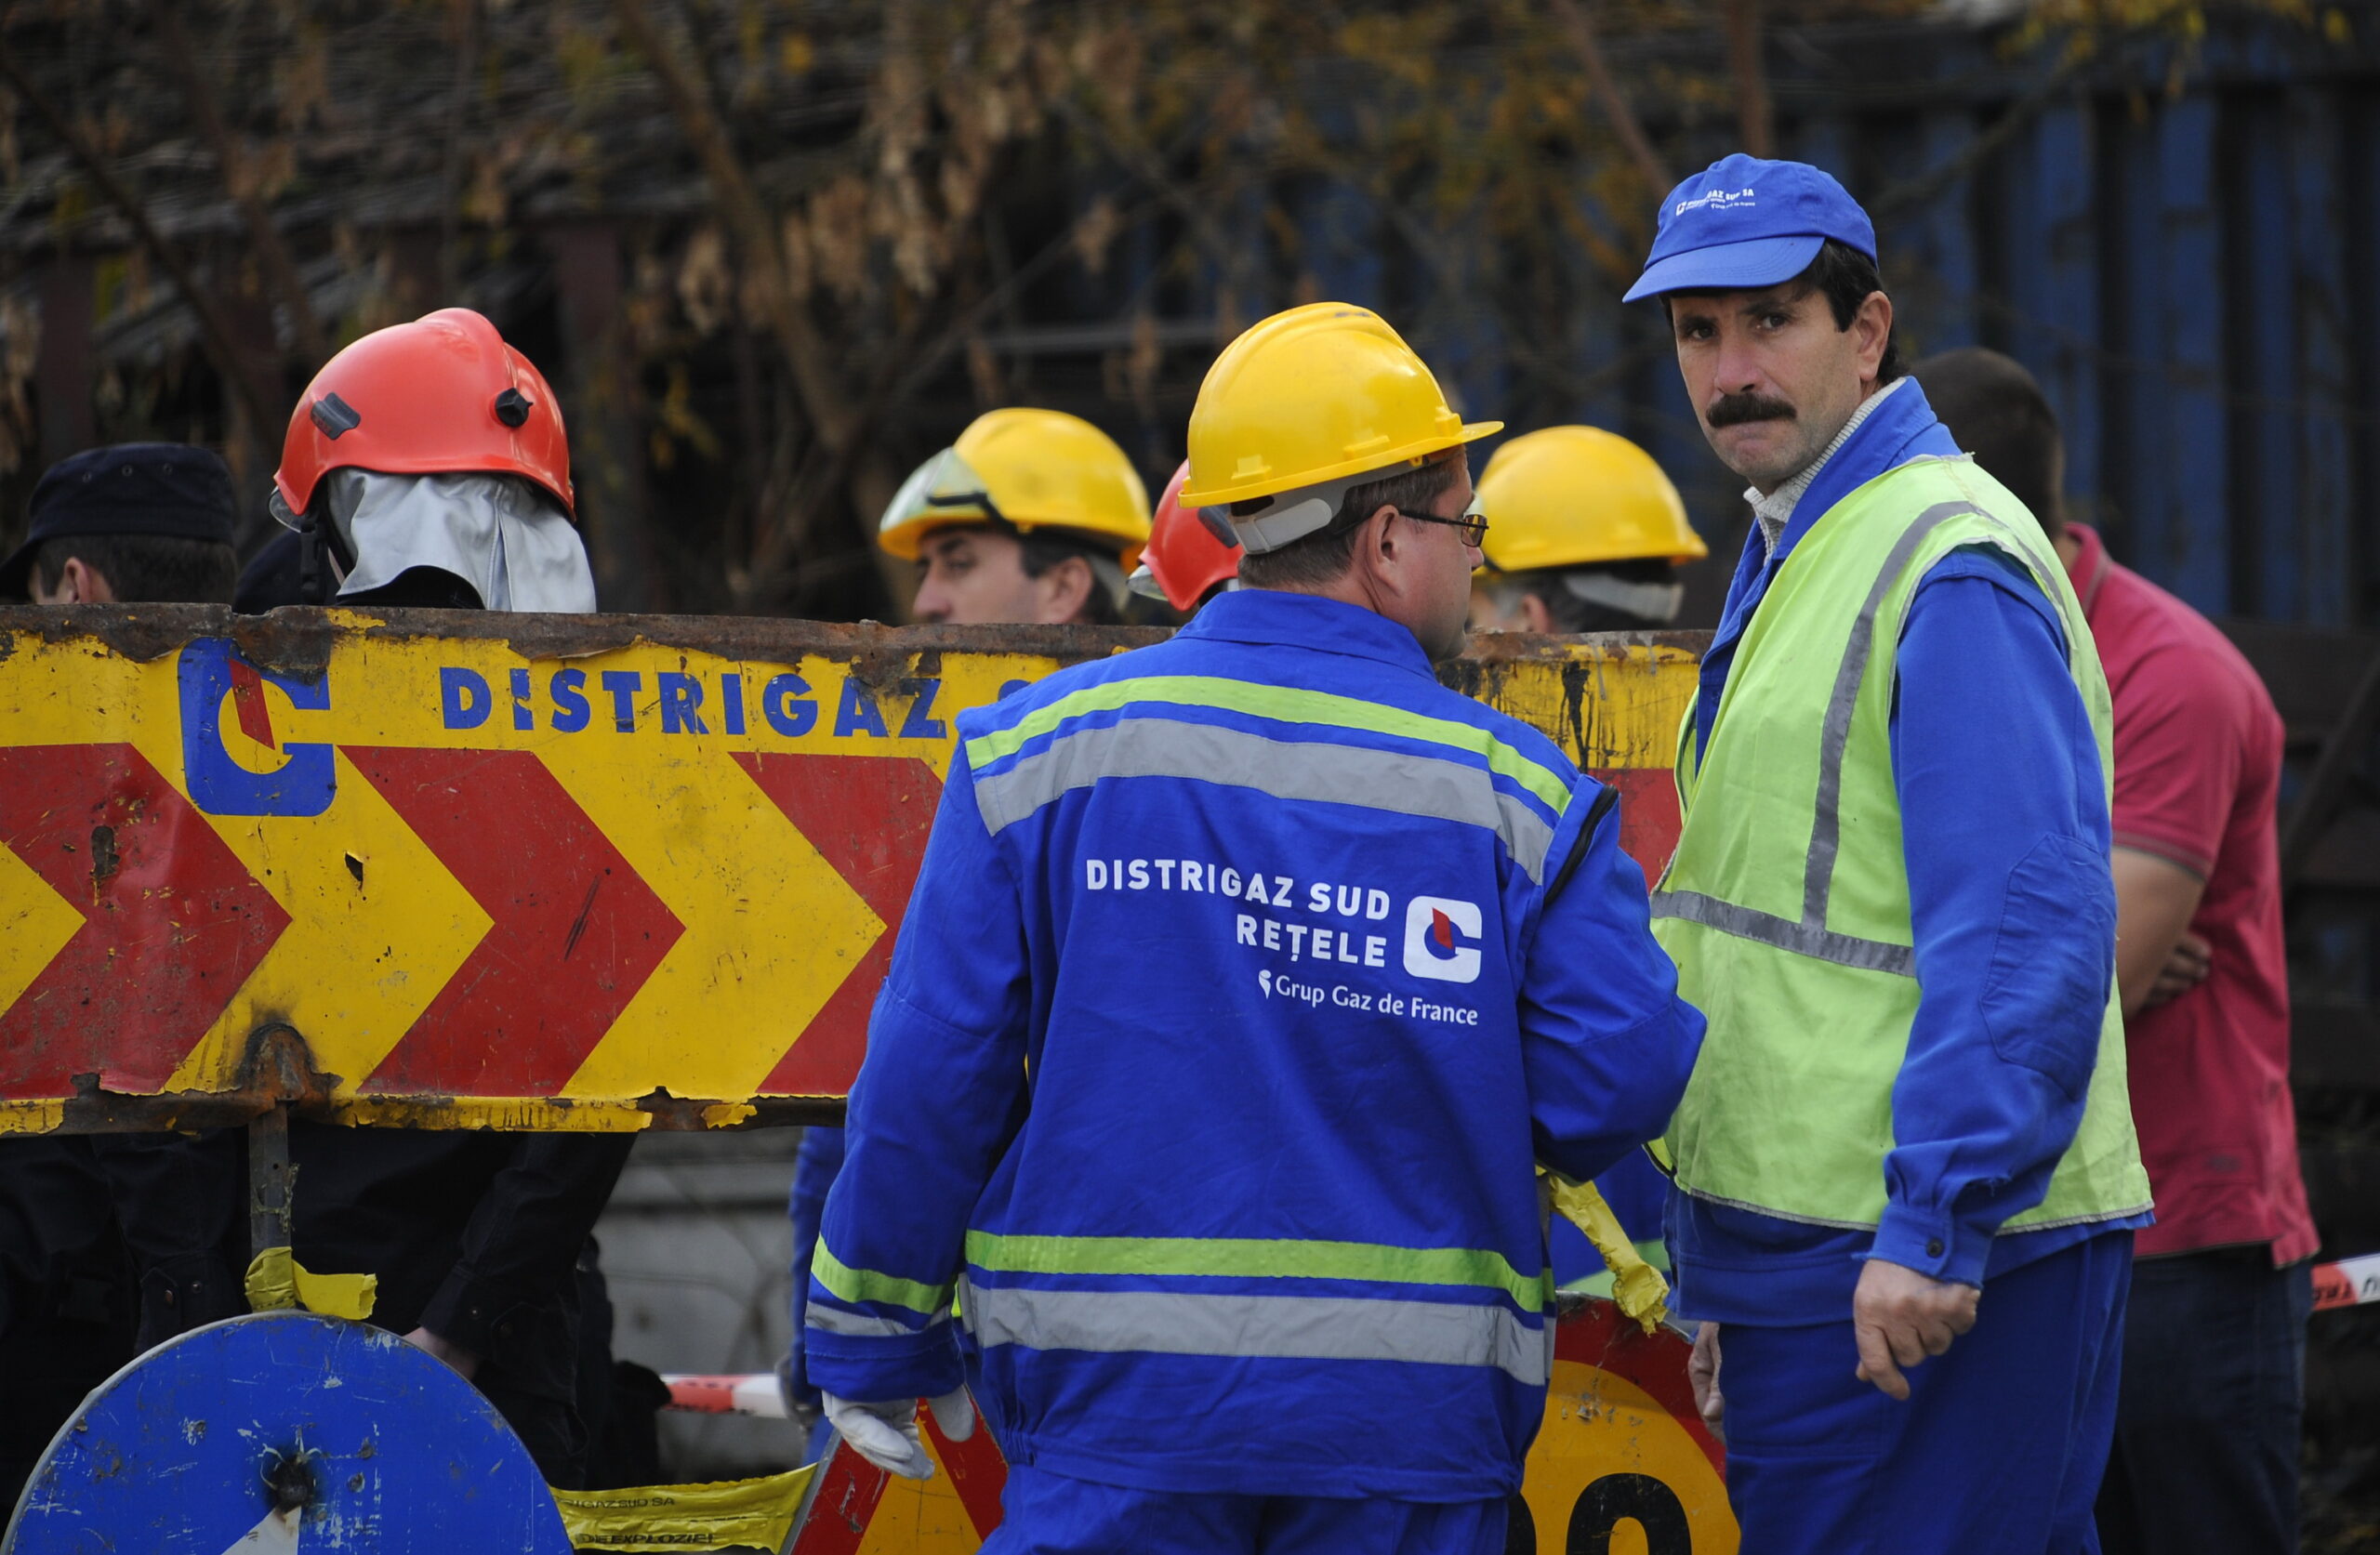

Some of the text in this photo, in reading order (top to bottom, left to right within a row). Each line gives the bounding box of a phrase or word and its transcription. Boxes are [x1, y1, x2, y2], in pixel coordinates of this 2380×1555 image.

[1742, 189, 1754, 197] SA
[439, 666, 946, 739] DISTRIGAZ
[1086, 858, 1391, 921] DISTRIGAZ SUD
[1236, 914, 1387, 968] REȚELE
[1276, 975, 1478, 1026] Grup Gaz de France
[651, 1496, 676, 1507] SA
